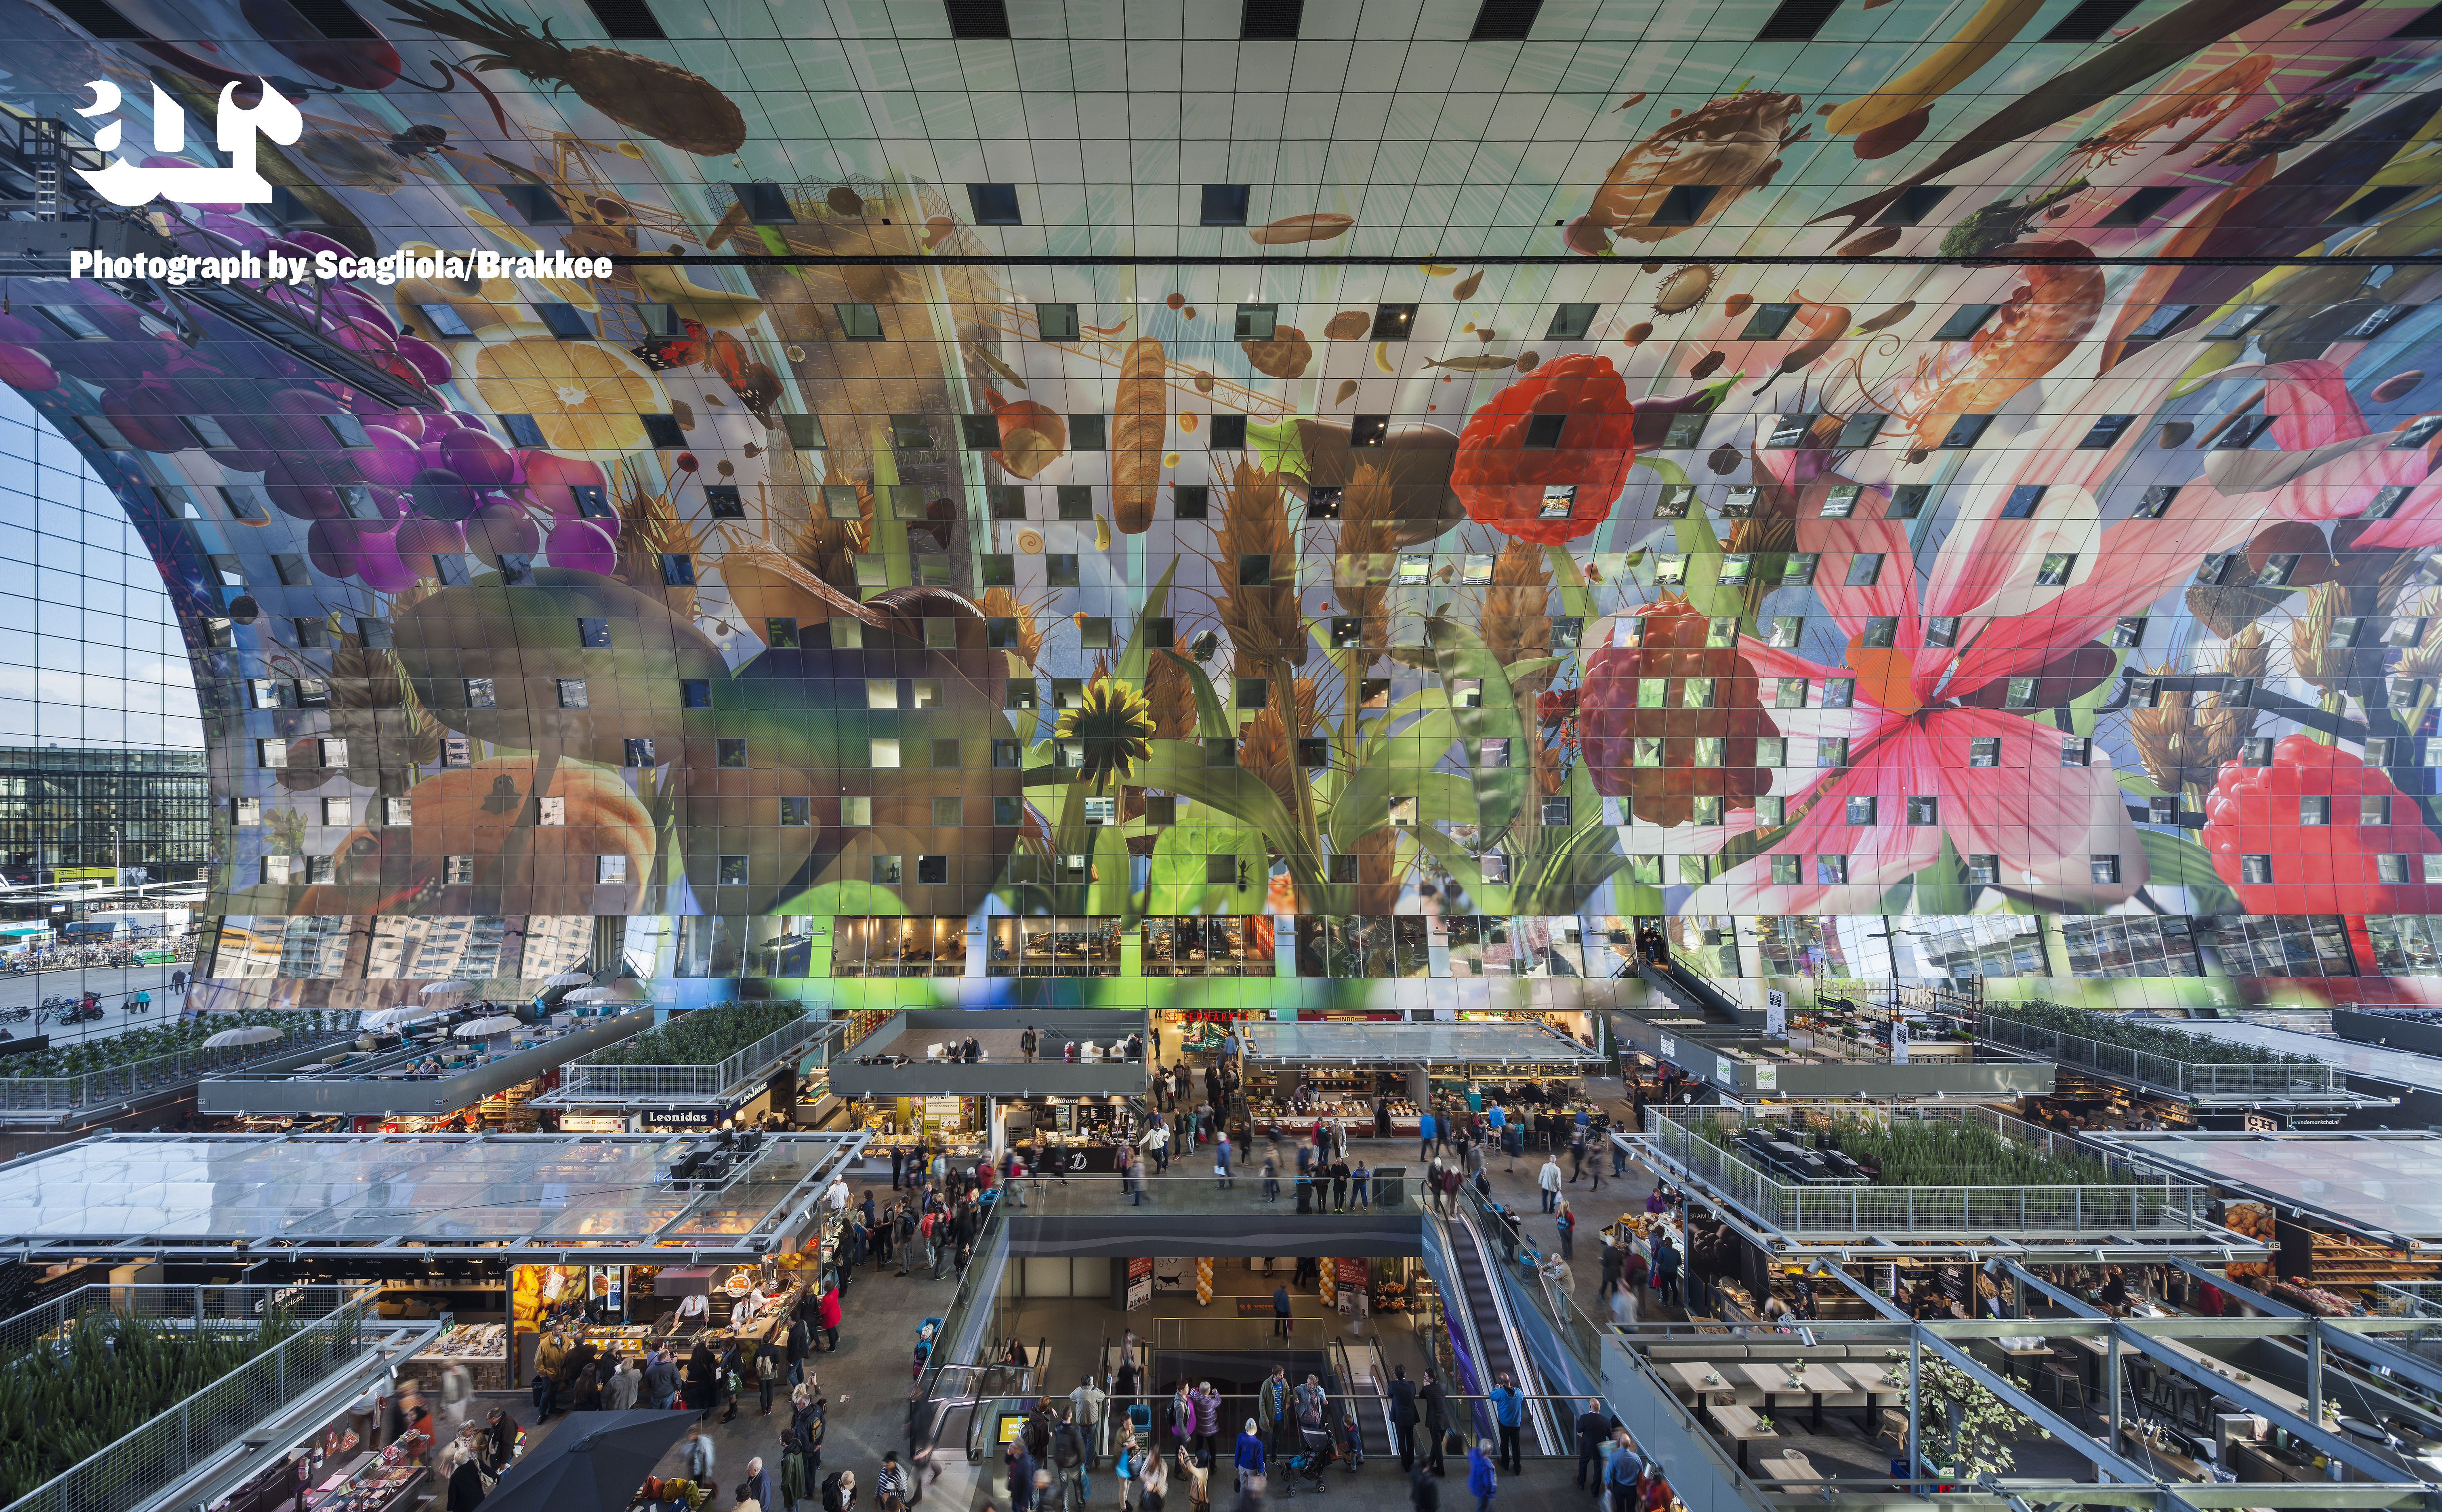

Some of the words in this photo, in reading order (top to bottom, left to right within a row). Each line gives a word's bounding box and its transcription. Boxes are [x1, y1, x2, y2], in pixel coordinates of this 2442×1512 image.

[1900, 989, 1934, 1004] VERS
[1166, 1012, 1249, 1022] SUPERMARKET
[1045, 1096, 1078, 1105] Délifrance
[649, 1111, 707, 1122] Leonidas
[1339, 1272, 1366, 1281] toiletervaring
